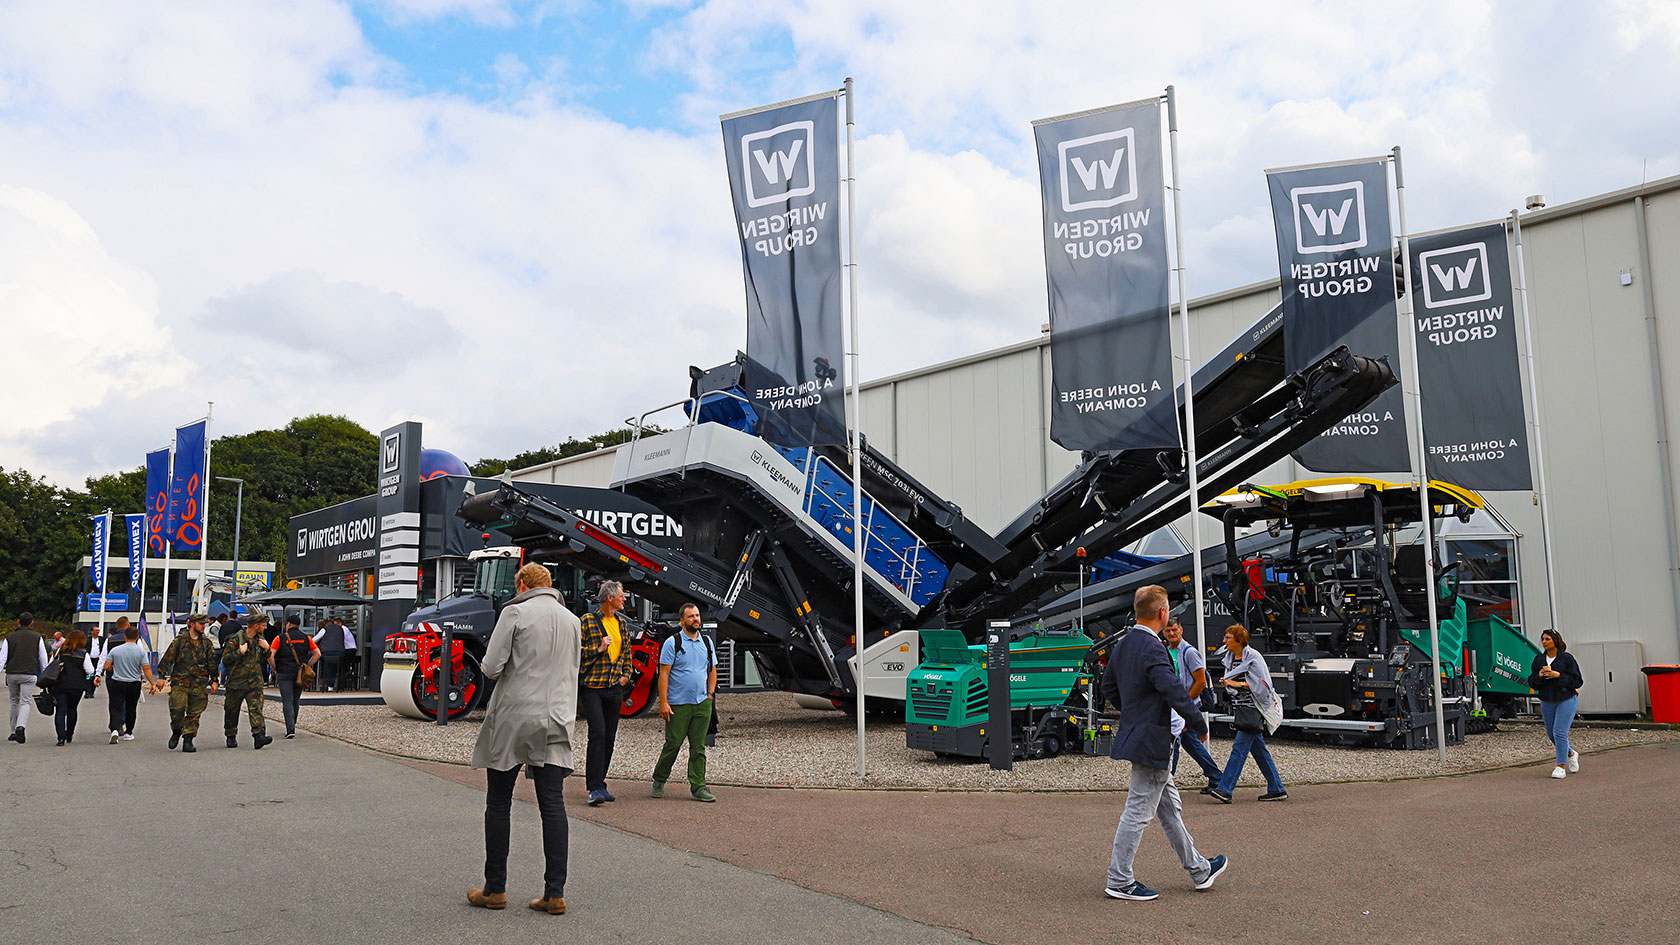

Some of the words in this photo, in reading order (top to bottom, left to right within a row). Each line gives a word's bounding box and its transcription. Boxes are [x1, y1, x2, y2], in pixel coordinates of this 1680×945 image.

[761, 459, 801, 495] KLEEMANN
[860, 451, 877, 468] REEN
[877, 465, 894, 481] MSC
[909, 489, 925, 504] EVO
[308, 523, 347, 551] WIRTGEN
[347, 516, 376, 543] GROU
[341, 553, 351, 561] JOHN
[351, 551, 362, 560] DEERE
[362, 549, 376, 558] COMPA
[697, 586, 724, 604] KLEEMAN
[887, 663, 904, 671] EVO
[1503, 656, 1522, 672] VÖGELE
[1009, 674, 1027, 682] ÖGELE
